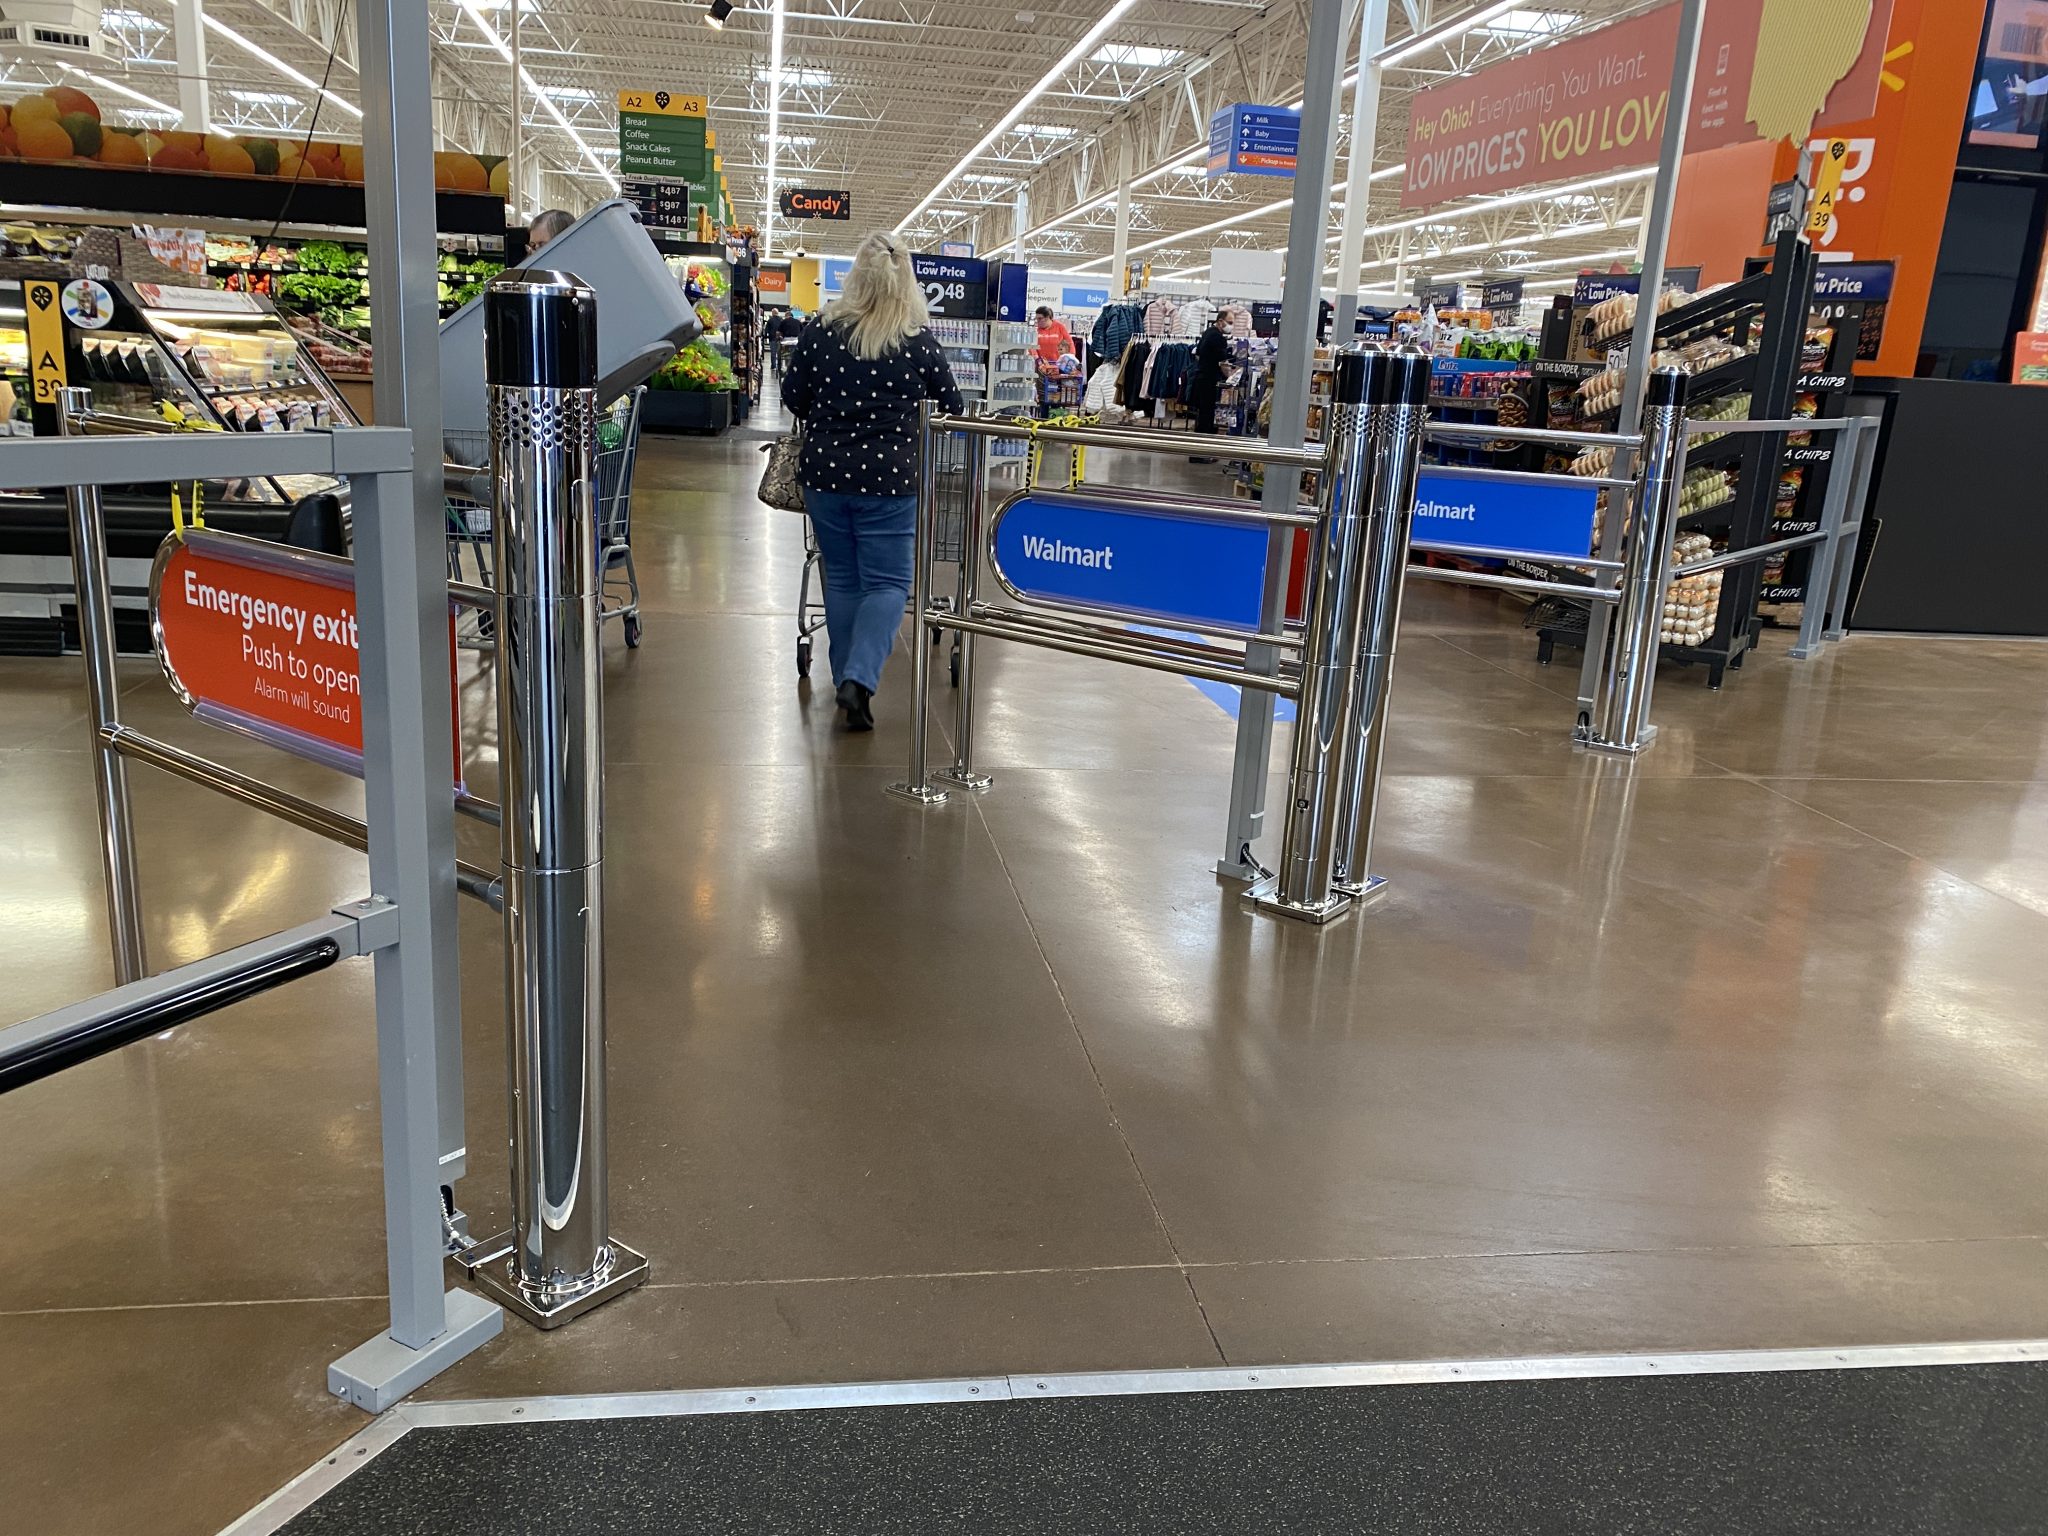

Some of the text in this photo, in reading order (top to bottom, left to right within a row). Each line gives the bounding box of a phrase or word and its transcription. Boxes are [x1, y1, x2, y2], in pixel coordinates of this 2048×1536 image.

[626, 96, 642, 108] A2
[1414, 51, 1648, 144] Hey Ohio! Everything You Want.
[683, 101, 698, 112] A3
[625, 117, 647, 126] Bread
[625, 129, 650, 139] Coffee
[1255, 130, 1270, 138] Baby
[1408, 90, 1668, 191] LOW PRICES YOU LOV
[625, 142, 671, 153] Snack Cakes
[1254, 144, 1294, 152] Entertainment
[625, 154, 676, 166] Peanut Butter
[1260, 157, 1278, 166] Pickup
[792, 193, 841, 215] Candy
[1819, 192, 1832, 206] A
[1814, 213, 1830, 227] 39
[916, 266, 966, 278] Low Price
[764, 277, 783, 288] Dairy
[1828, 276, 1862, 293] Price
[1086, 294, 1104, 304] Baby
[1438, 294, 1449, 304] Price
[1490, 290, 1514, 303] Low Price
[1588, 286, 1627, 300] Low Price
[38, 350, 59, 371] A
[1536, 362, 1544, 371] ON
[1544, 362, 1554, 372] THE
[1809, 376, 1846, 387] CHIPS
[1794, 450, 1831, 460] CHIPS
[1782, 522, 1818, 532] CHIPS
[1022, 535, 1113, 570] Walmart
[1516, 560, 1526, 570] THE
[184, 569, 360, 650] Emergency exit
[242, 633, 361, 696] Push to open
[254, 676, 351, 724] Alarm will sound
